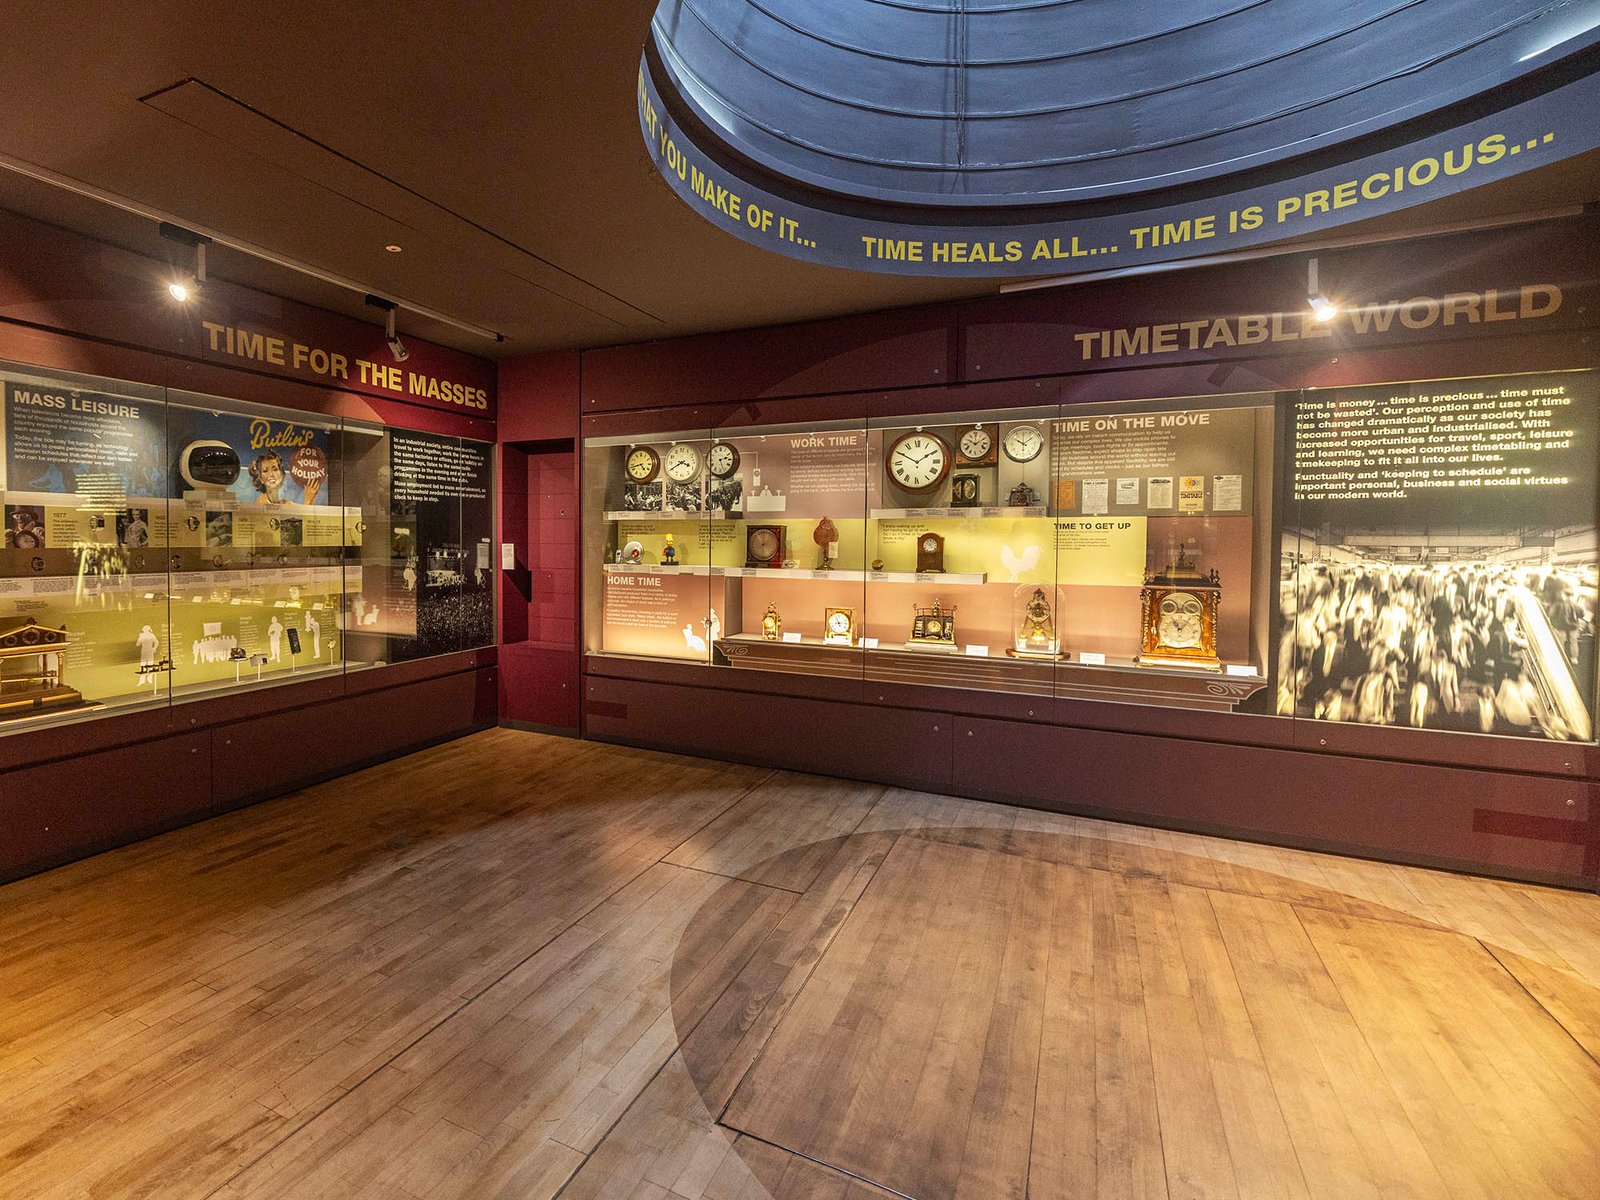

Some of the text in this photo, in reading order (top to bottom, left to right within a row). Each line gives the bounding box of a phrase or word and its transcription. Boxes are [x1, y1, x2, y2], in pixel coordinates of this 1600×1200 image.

[660, 124, 686, 181] YOU
[692, 165, 740, 221] MAKE
[747, 204, 774, 232] OF
[1130, 132, 1554, 249] TIME IS PRECIOUS...
[862, 236, 1118, 263] TIME HEALS ALL...
[1344, 284, 1563, 334] WORLD
[202, 320, 488, 410] TIME FOR THE MASSES
[1532, 386, 1564, 396] must
[14, 391, 140, 418] MASS LEISURE
[1406, 404, 1469, 416] perception
[1472, 401, 1496, 410] and
[1525, 398, 1538, 406] of
[1542, 397, 1571, 406] time
[1052, 414, 1210, 432] TIME ON THE MOVE
[1296, 422, 1315, 430] has
[1318, 419, 1364, 430] changed
[1367, 415, 1436, 426] dramatically
[1481, 410, 1525, 420] society
[1529, 409, 1552, 417] has
[250, 418, 314, 449] Butlin's
[1296, 431, 1338, 439] become
[1372, 426, 1404, 435] urban
[1408, 425, 1429, 433] and
[1432, 421, 1518, 432] industrialised.
[1522, 420, 1550, 428] With
[791, 436, 857, 448] WORK TIME
[1296, 430, 1574, 448] increased opportunities for travel, sport, leisure
[300, 448, 316, 456] FOR
[1296, 450, 1315, 458] and
[1318, 449, 1365, 458] learning,
[1388, 446, 1416, 454] need
[1420, 441, 1468, 454] complex
[1472, 441, 1541, 451] timetabling
[1544, 440, 1569, 448] and
[298, 458, 320, 468] YOUR
[1295, 458, 1360, 468] tmekeeping
[1378, 456, 1390, 464] fit
[1394, 456, 1402, 464] it
[1405, 456, 1418, 464] all
[1422, 454, 1446, 464] into
[1472, 454, 1503, 462] lives.
[292, 466, 325, 478] HOLIDAY
[1295, 472, 1354, 481] Punctuality
[1358, 471, 1378, 479] and
[1349, 480, 1400, 490] personal,
[1404, 479, 1455, 488] business
[1458, 478, 1481, 486] and
[1484, 477, 1520, 486] social
[1524, 476, 1568, 485] virtues
[1328, 491, 1369, 500] modern
[1372, 490, 1407, 498] world.
[608, 576, 661, 586] HOME TIME
